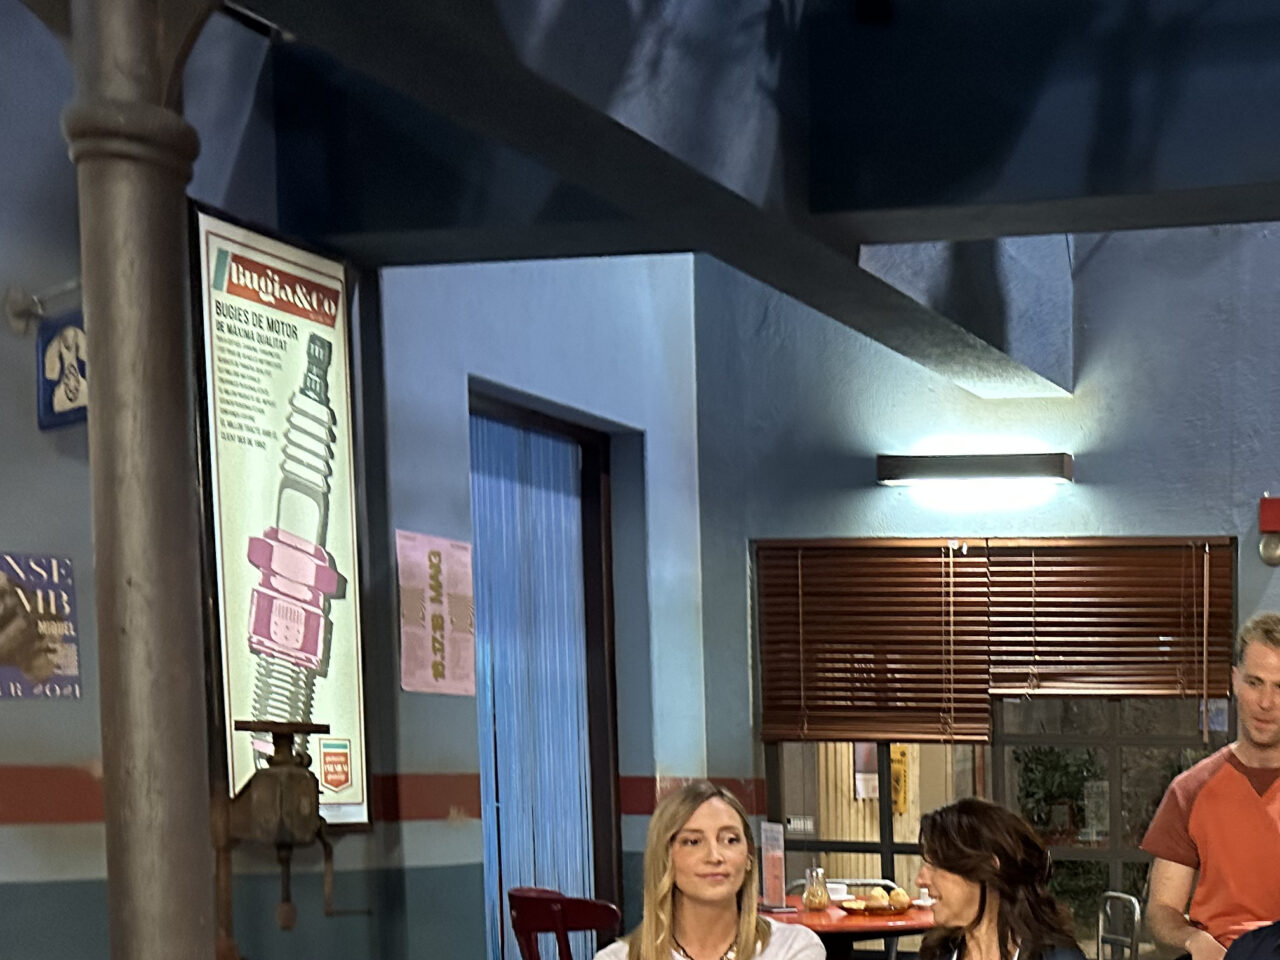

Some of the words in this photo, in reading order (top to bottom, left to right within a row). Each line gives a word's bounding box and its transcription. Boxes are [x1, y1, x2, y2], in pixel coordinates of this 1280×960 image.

[215, 299, 250, 328] BUGIES
[251, 311, 264, 330] DE
[265, 316, 298, 340] MOTOR
[215, 320, 225, 334] DE
[256, 331, 287, 352] QUALITAT
